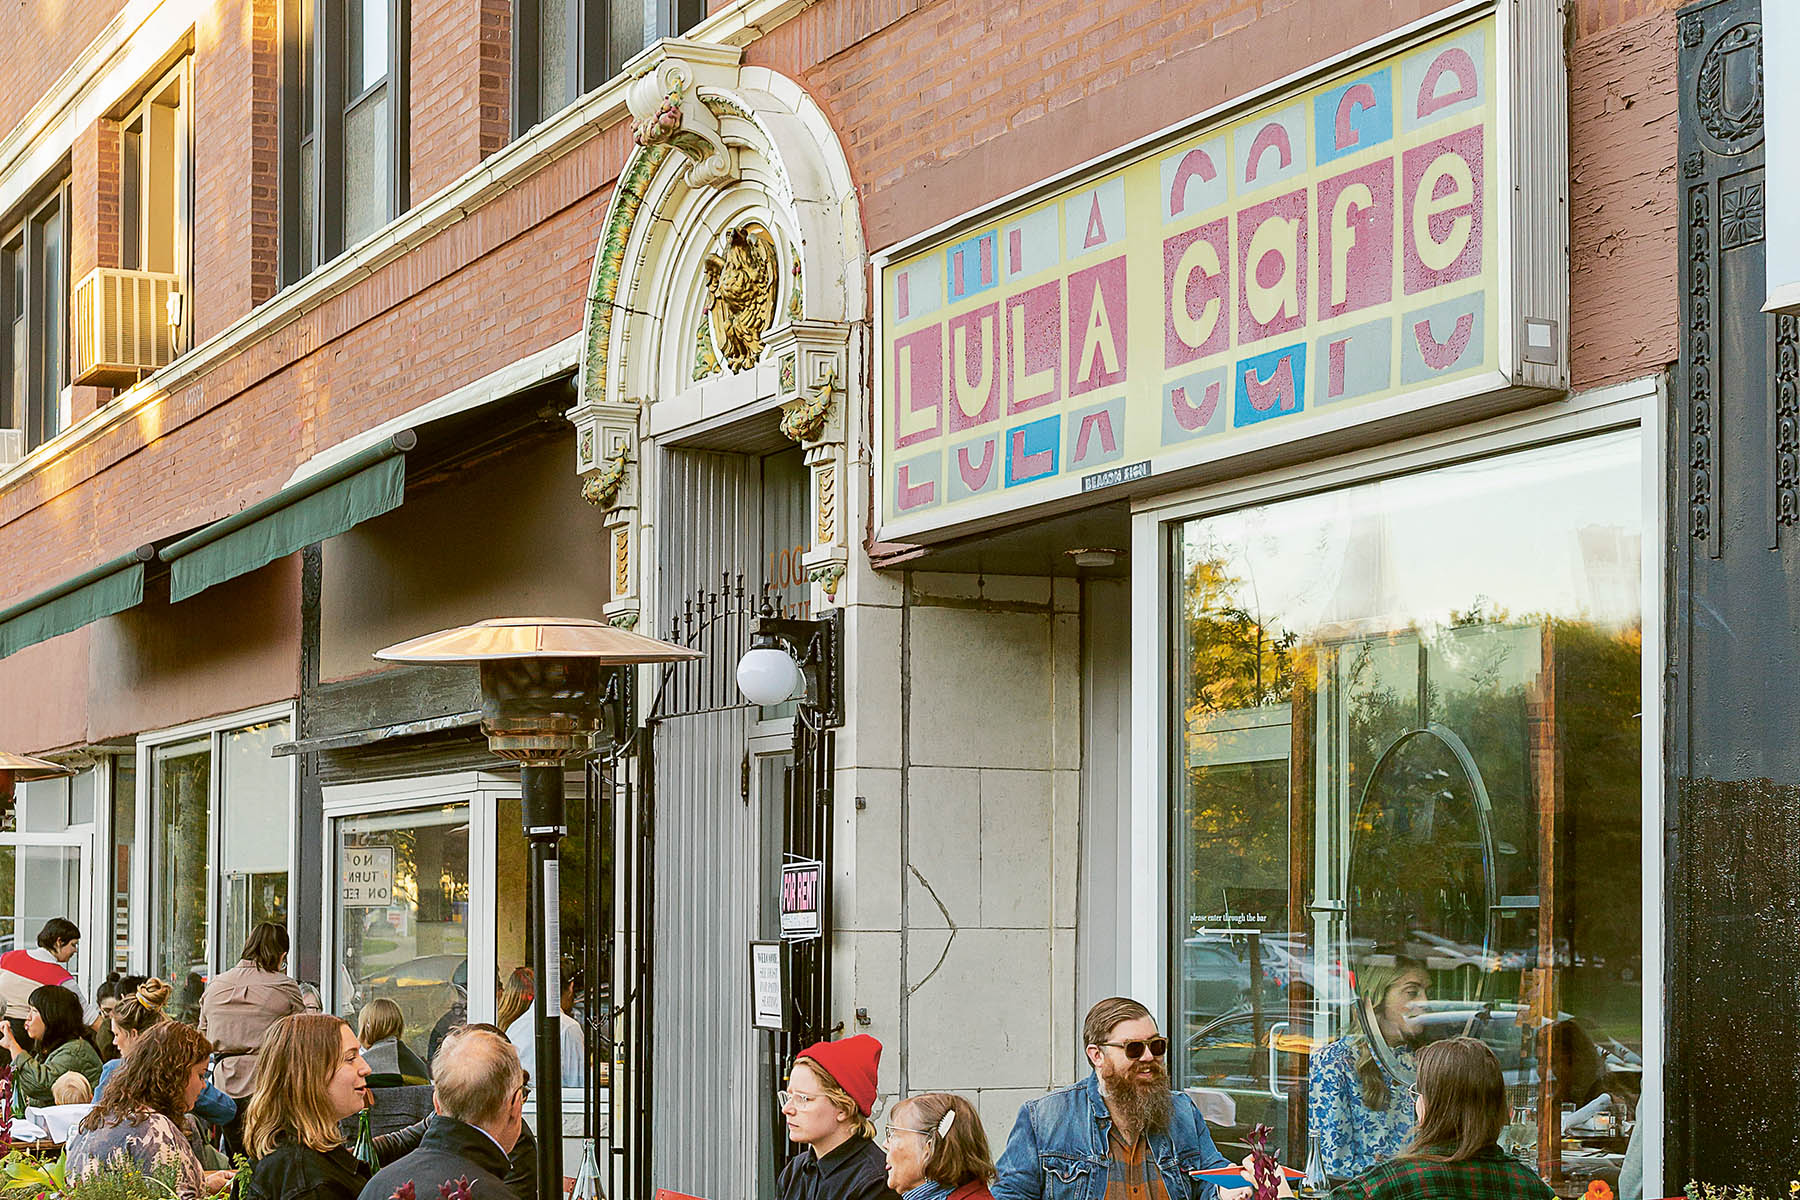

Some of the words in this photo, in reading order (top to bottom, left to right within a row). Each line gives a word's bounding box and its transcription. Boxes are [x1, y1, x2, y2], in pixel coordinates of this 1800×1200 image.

[900, 276, 1121, 438] LULA
[1124, 463, 1147, 480] SIGN
[783, 872, 796, 912] FOR
[797, 870, 818, 911] RENT
[1190, 912, 1207, 924] please
[1208, 914, 1222, 922] enter
[1223, 912, 1245, 925] through
[1246, 912, 1256, 922] the
[1257, 912, 1267, 922] bar
